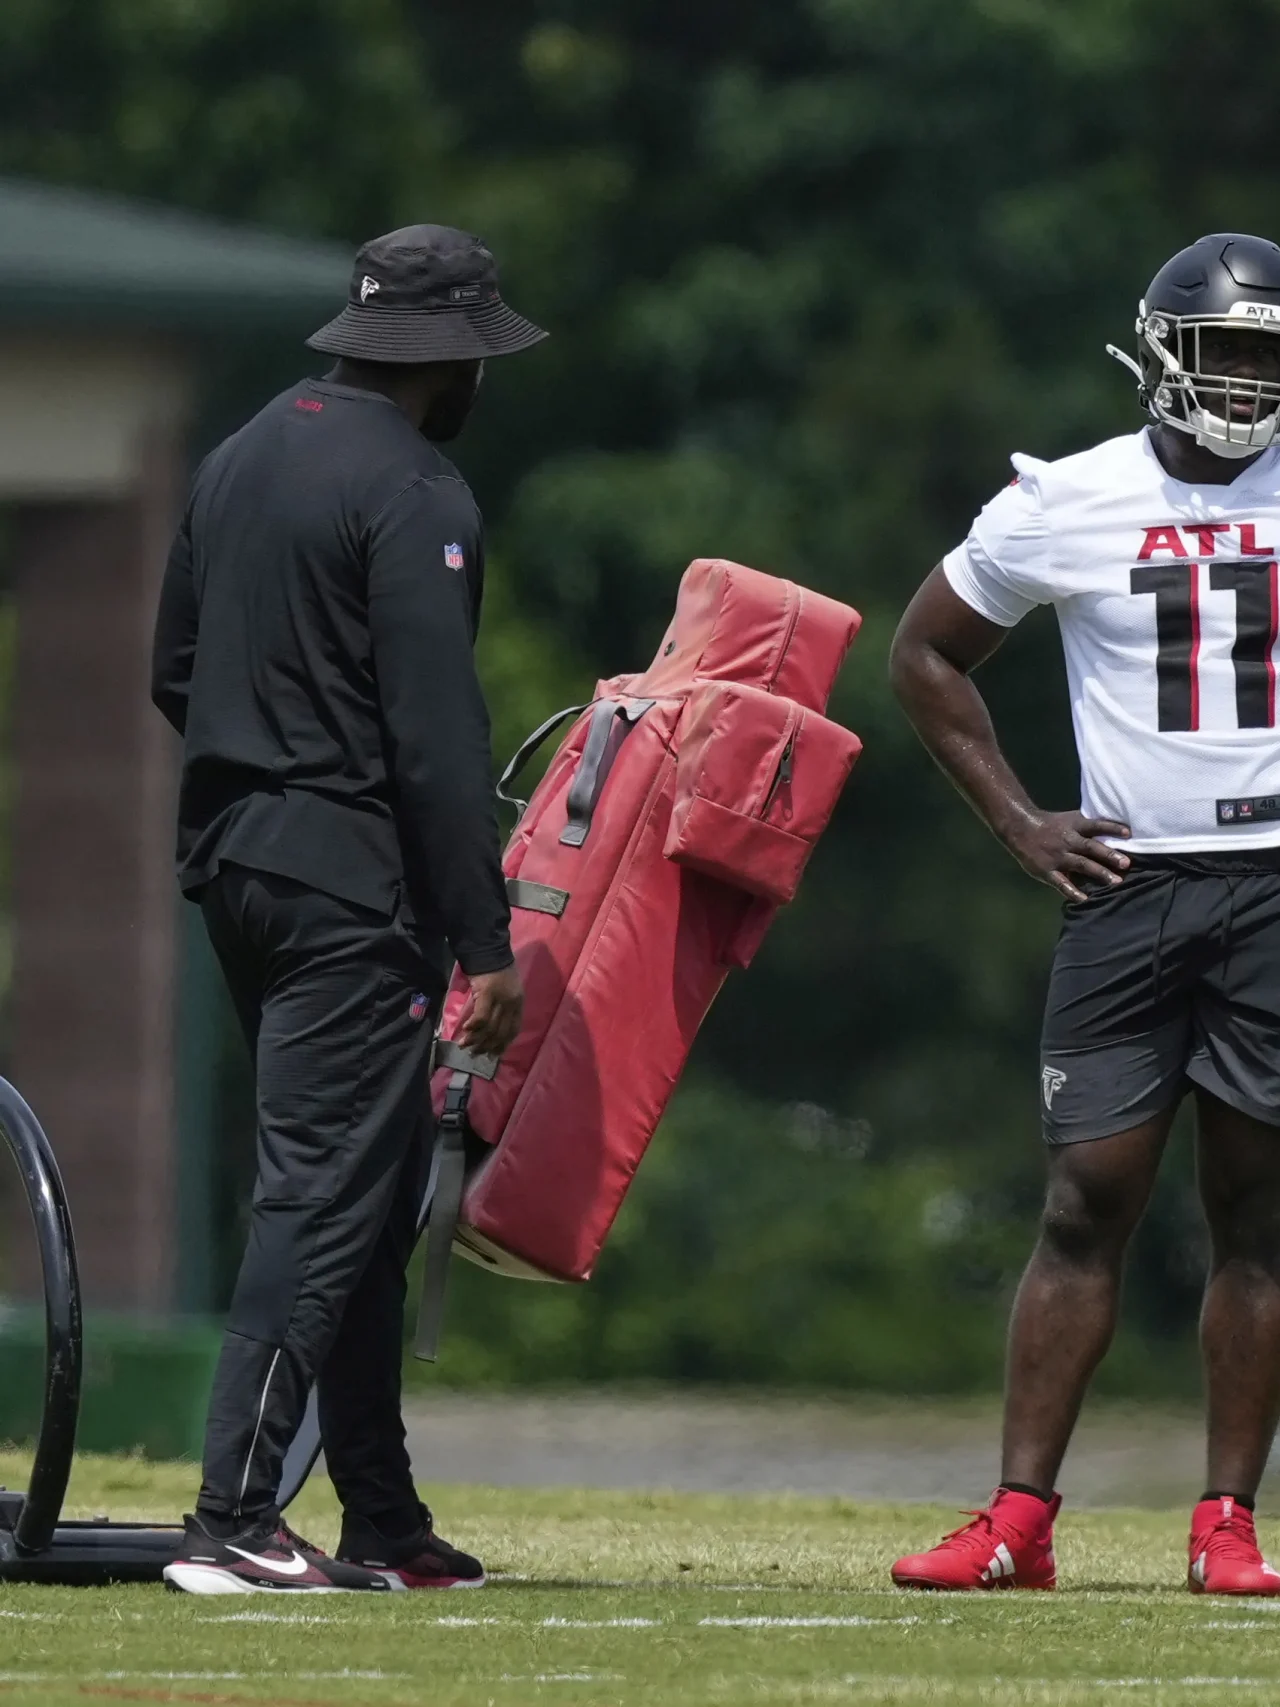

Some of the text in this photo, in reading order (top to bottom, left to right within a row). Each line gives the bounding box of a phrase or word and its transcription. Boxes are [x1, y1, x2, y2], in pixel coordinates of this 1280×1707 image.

[1245, 306, 1276, 319] ATL
[1136, 523, 1275, 561] ATL
[1129, 560, 1279, 732] 11
